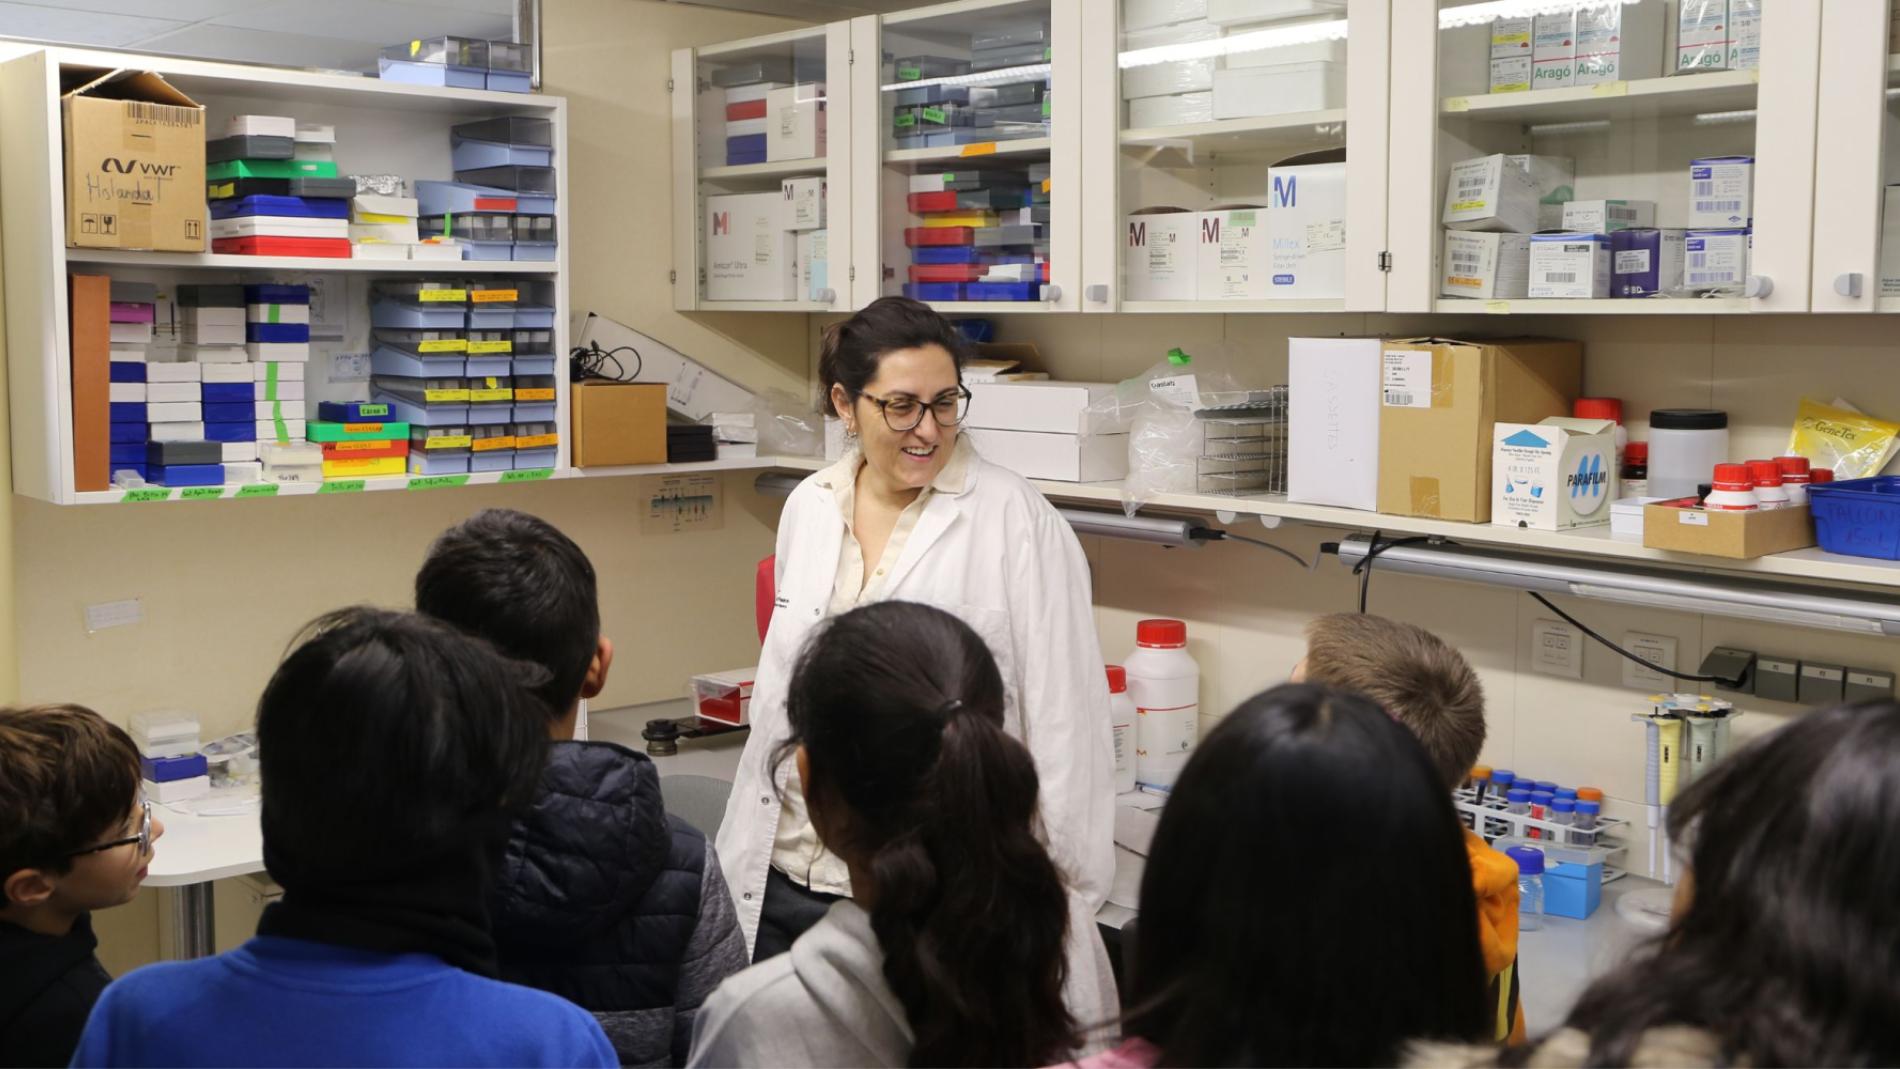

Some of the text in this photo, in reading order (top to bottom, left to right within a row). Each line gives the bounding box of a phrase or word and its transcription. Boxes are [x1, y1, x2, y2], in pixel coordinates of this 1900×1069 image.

[1534, 65, 1572, 81] Aragó
[140, 162, 176, 176] vwr
[1273, 175, 1297, 208] M
[713, 211, 729, 236] M
[1129, 221, 1146, 247] M
[1202, 217, 1220, 244] M
[1815, 421, 1857, 440] GeneTex
[1567, 472, 1607, 487] PARAFILM
